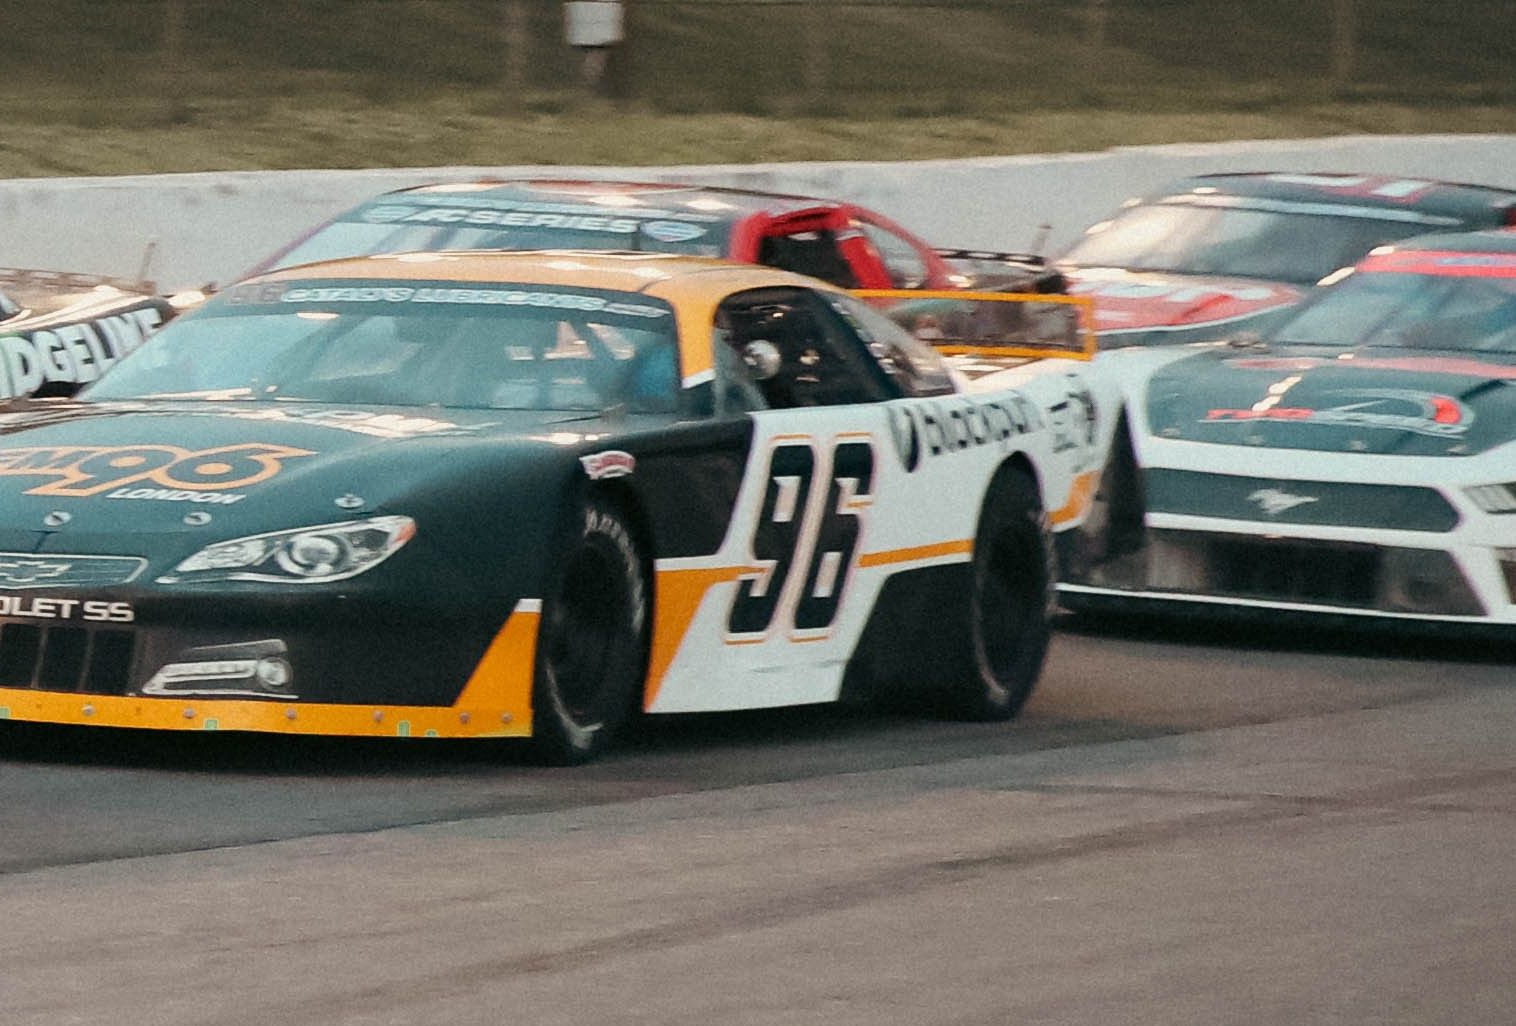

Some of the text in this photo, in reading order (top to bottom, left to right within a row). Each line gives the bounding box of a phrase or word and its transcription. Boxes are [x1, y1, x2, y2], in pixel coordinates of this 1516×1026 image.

[105, 488, 247, 505] LONDON
[723, 433, 876, 645] 96
[82, 601, 135, 622] SS
